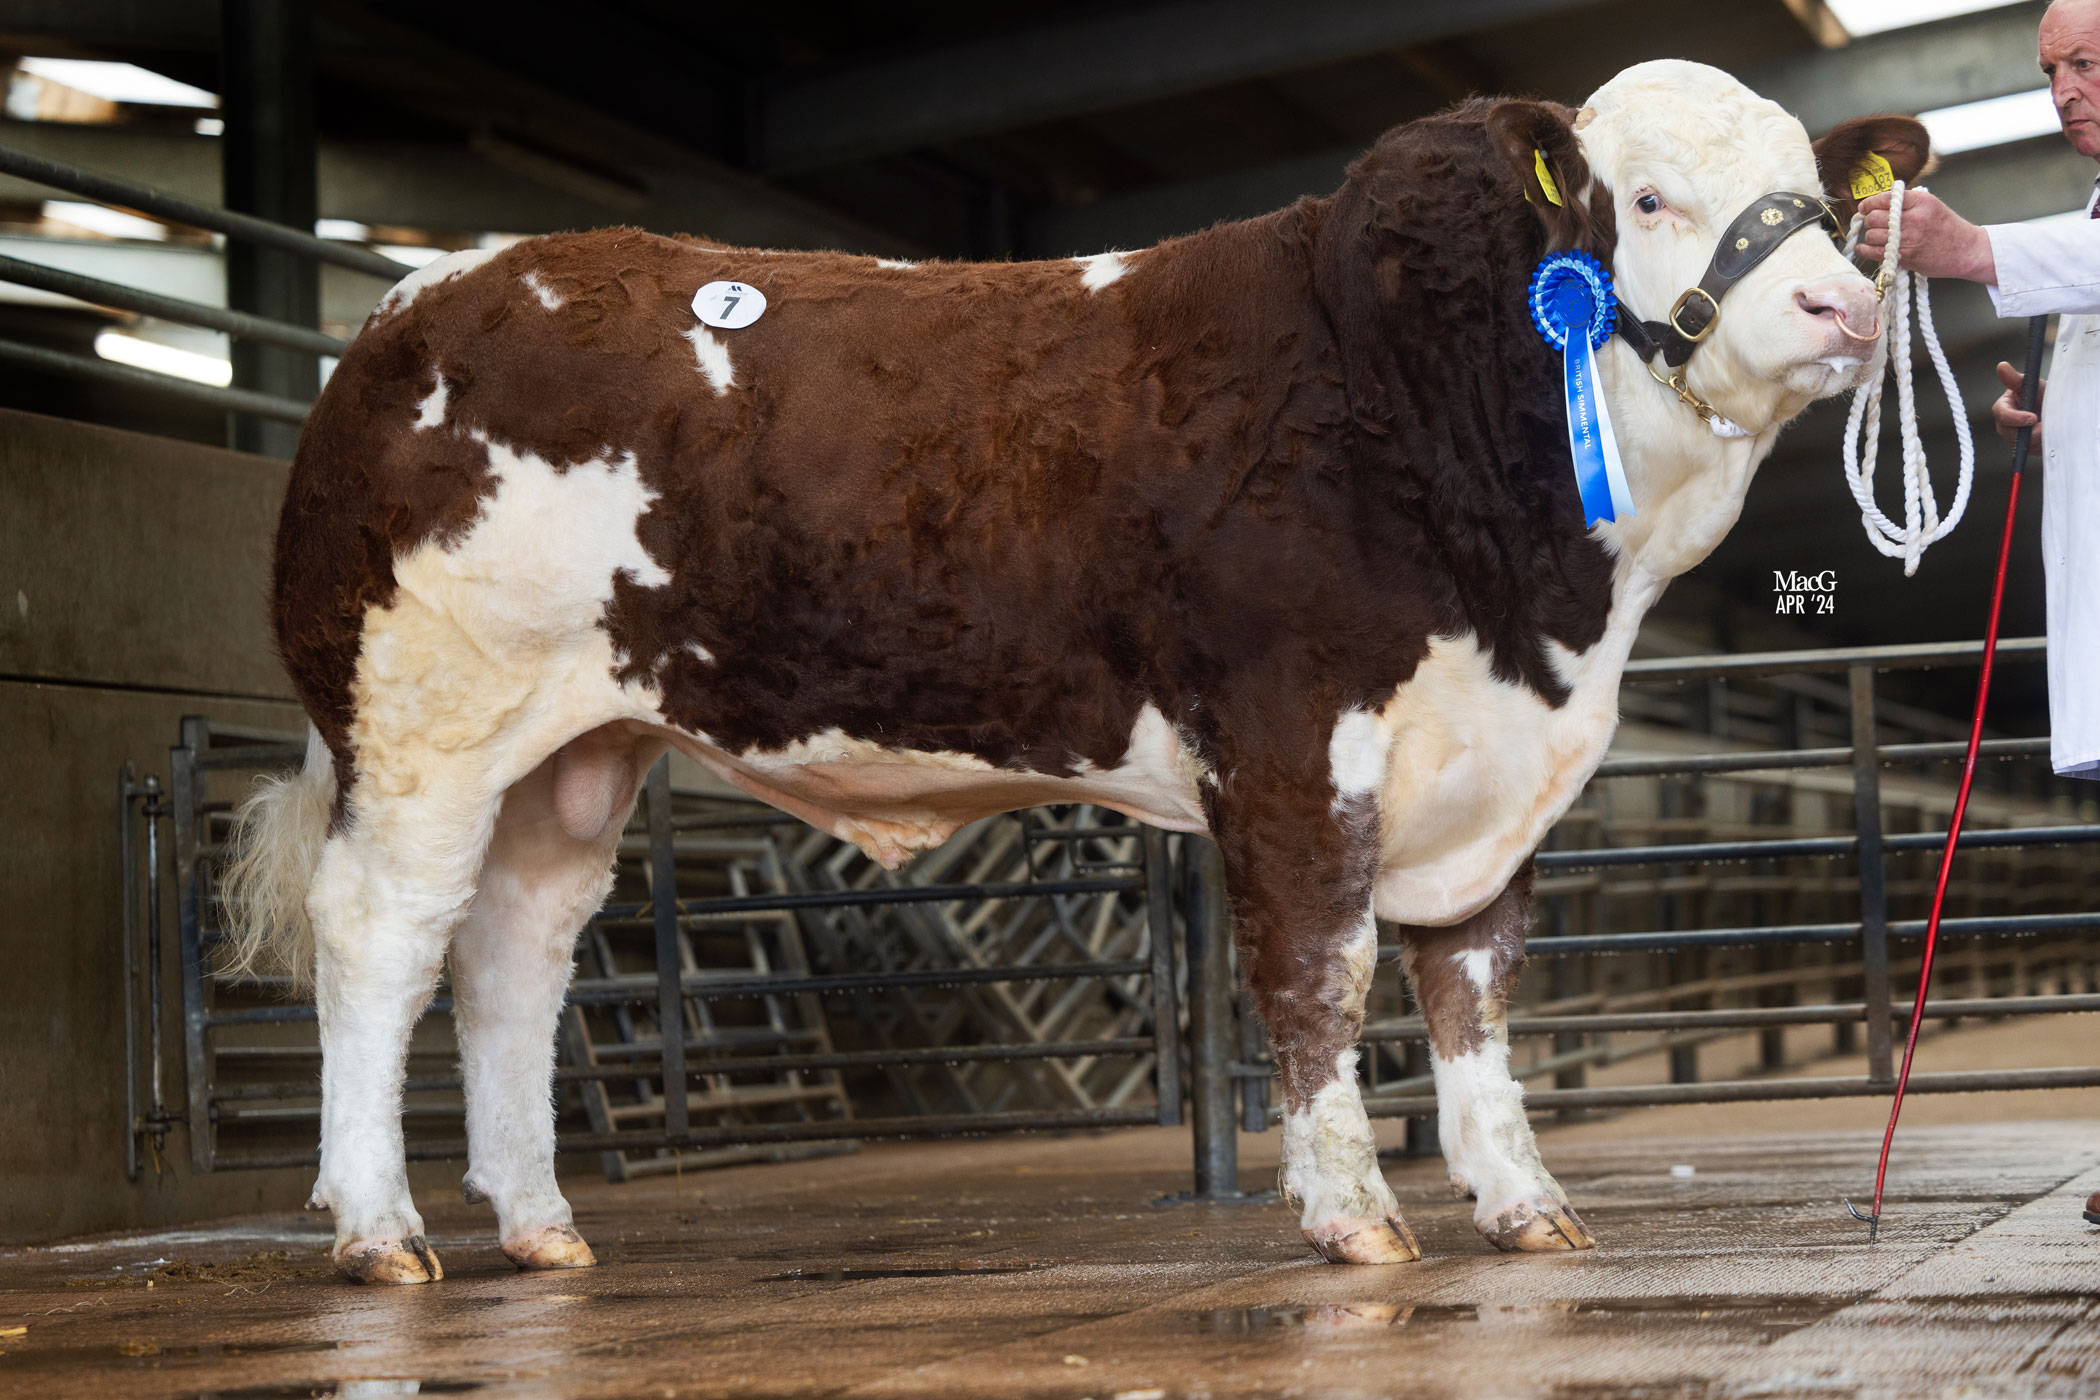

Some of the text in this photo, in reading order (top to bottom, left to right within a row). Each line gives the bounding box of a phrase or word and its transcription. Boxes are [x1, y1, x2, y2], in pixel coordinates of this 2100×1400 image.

[720, 296, 741, 320] 7
[1574, 358, 1592, 450] BRITISH SIMMENTAL
